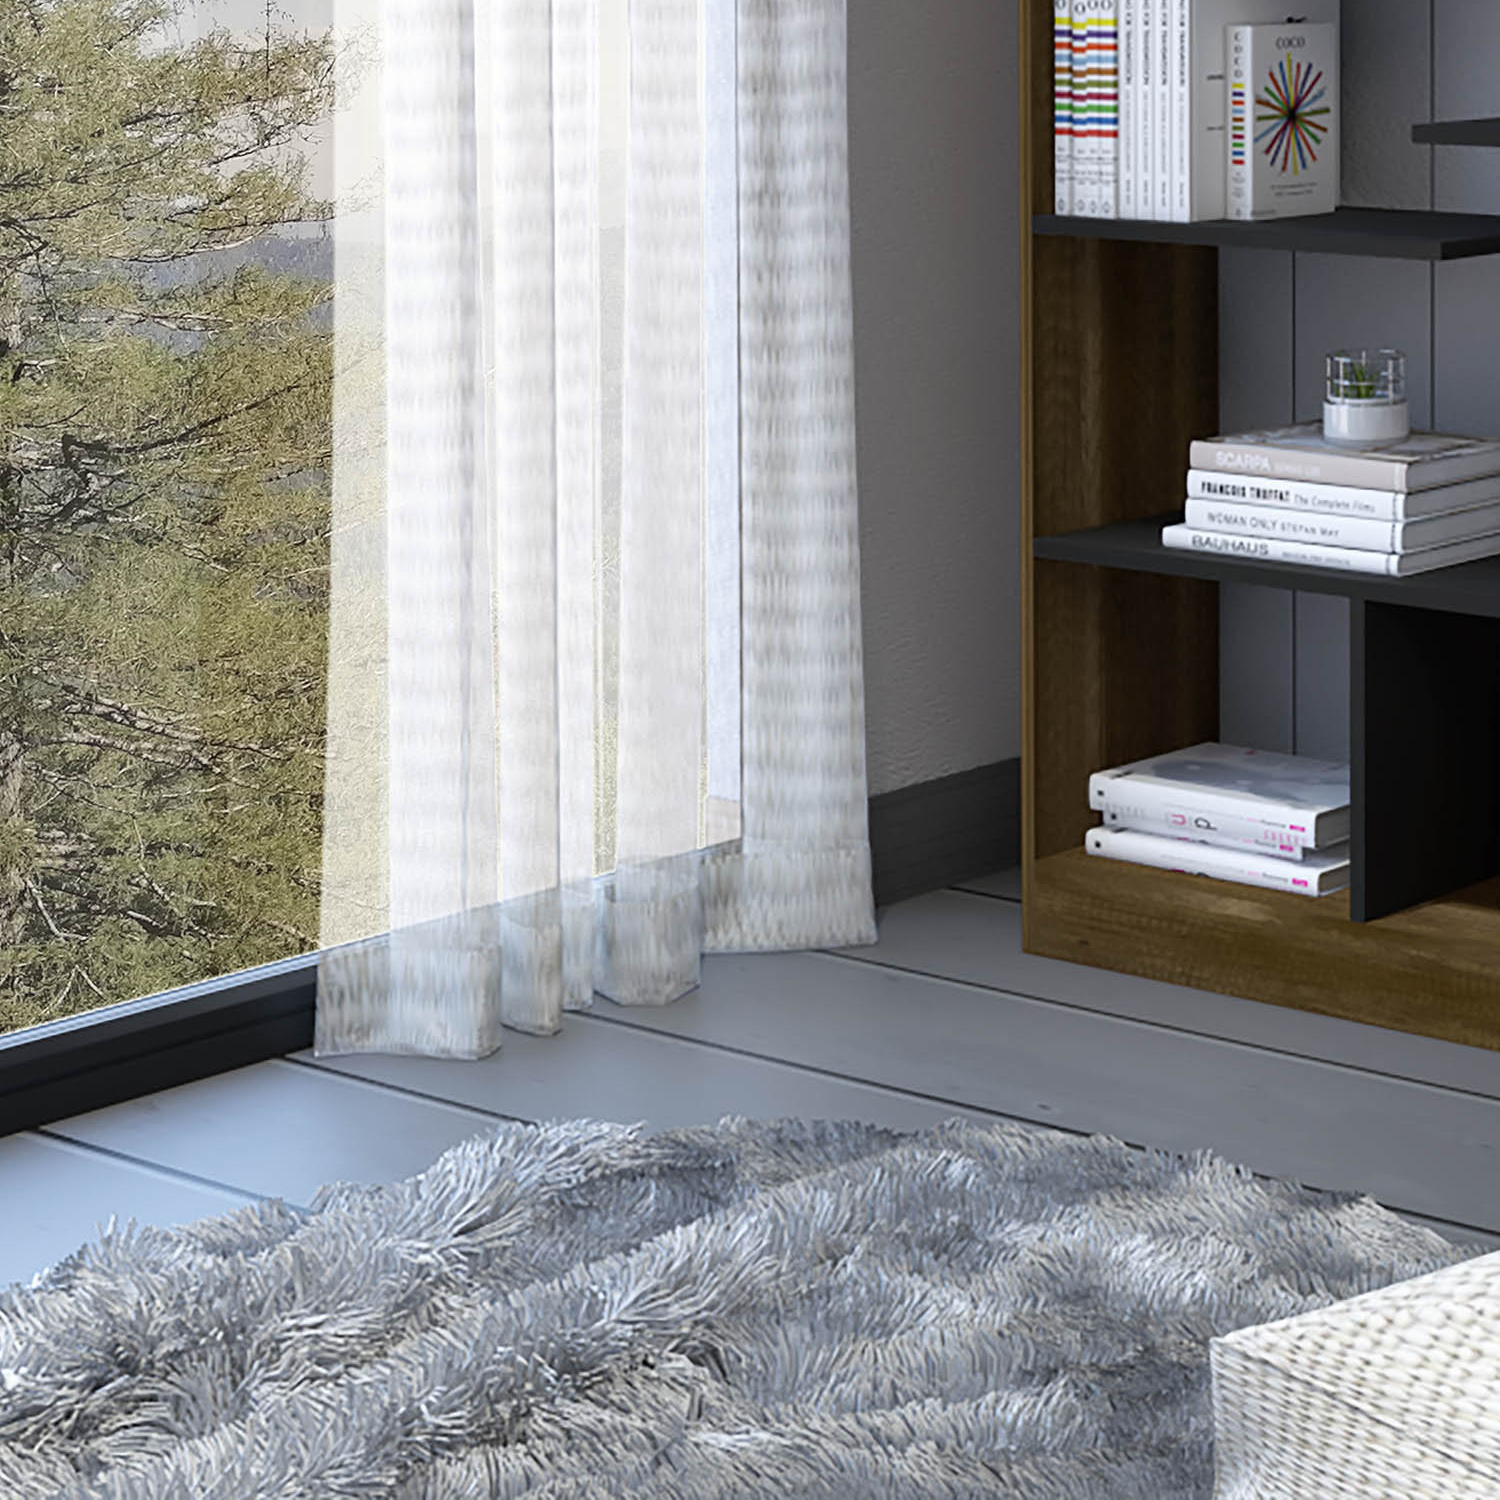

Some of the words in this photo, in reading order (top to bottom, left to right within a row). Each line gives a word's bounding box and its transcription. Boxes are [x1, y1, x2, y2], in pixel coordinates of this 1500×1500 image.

[1215, 451, 1270, 470] SCARPA
[1201, 481, 1246, 498] FRANCOIS
[1294, 493, 1309, 505] The
[1250, 517, 1276, 532] ONLY
[1192, 536, 1269, 556] BAUHAUS
